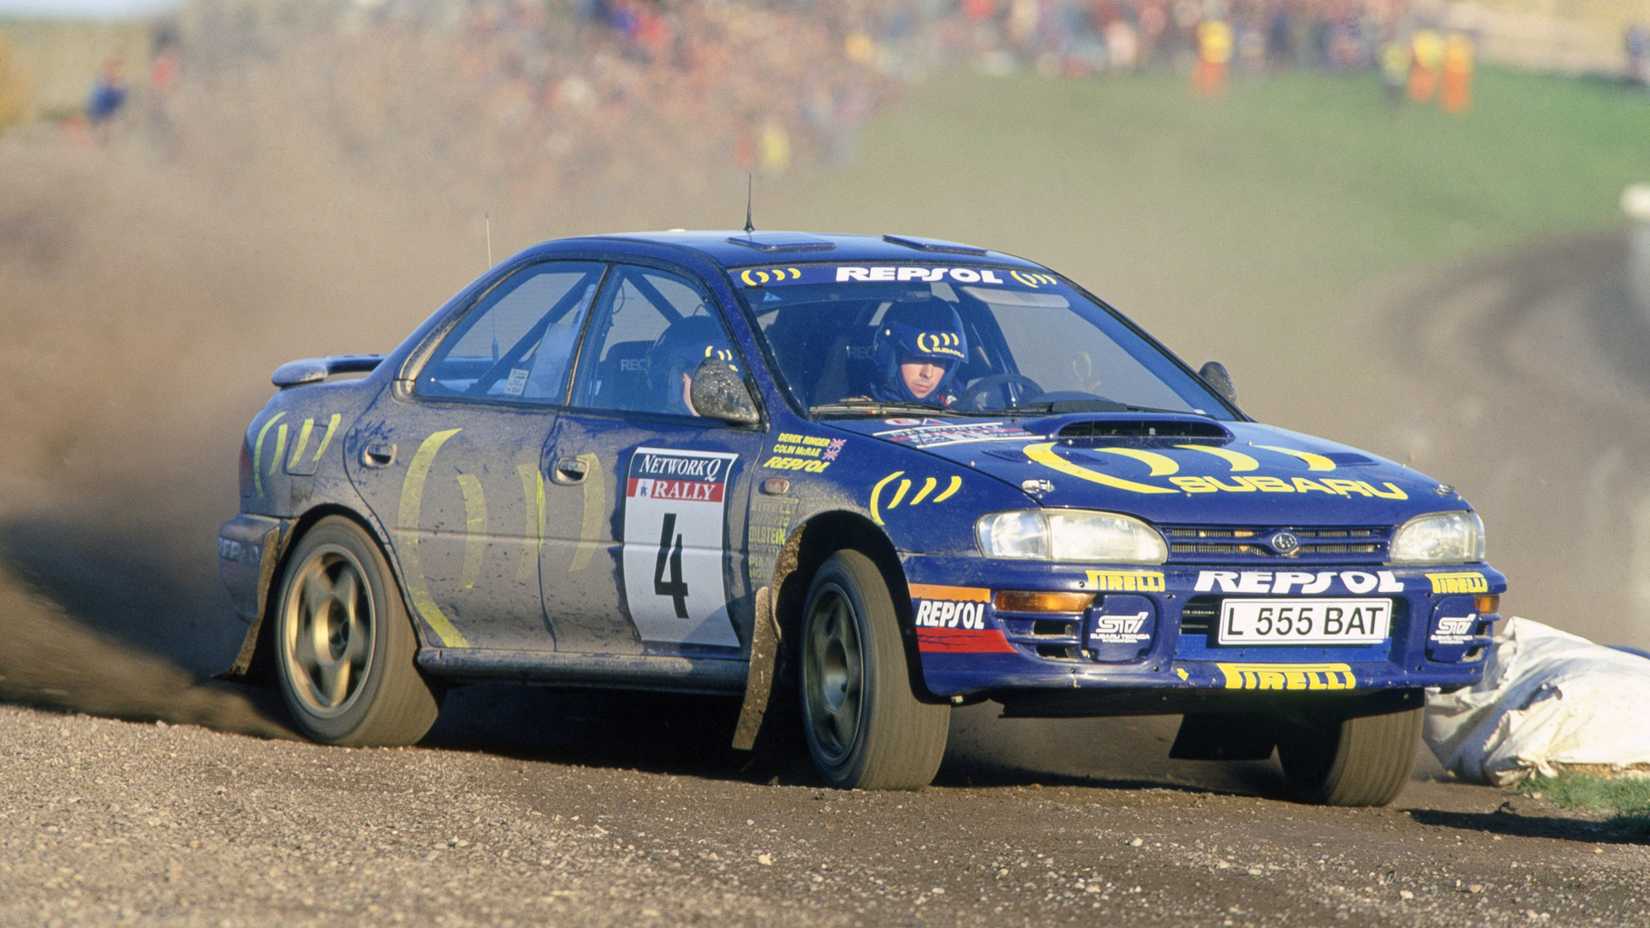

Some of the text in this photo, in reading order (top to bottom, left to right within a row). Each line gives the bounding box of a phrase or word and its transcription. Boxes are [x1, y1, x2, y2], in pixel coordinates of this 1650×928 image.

[836, 266, 1003, 284] REPSOL
[763, 456, 830, 473] REPSOL
[653, 480, 716, 500] RALLY
[1169, 476, 1408, 500] SUBARU
[654, 512, 689, 619] 4
[1085, 570, 1166, 592] PIRELLI
[1194, 570, 1404, 594] REPSOL
[1424, 572, 1488, 593] PIRELLI
[916, 600, 985, 629] REPSOL
[1227, 607, 1384, 635] L 555 BAT
[1216, 663, 1356, 689] PIRELLI
